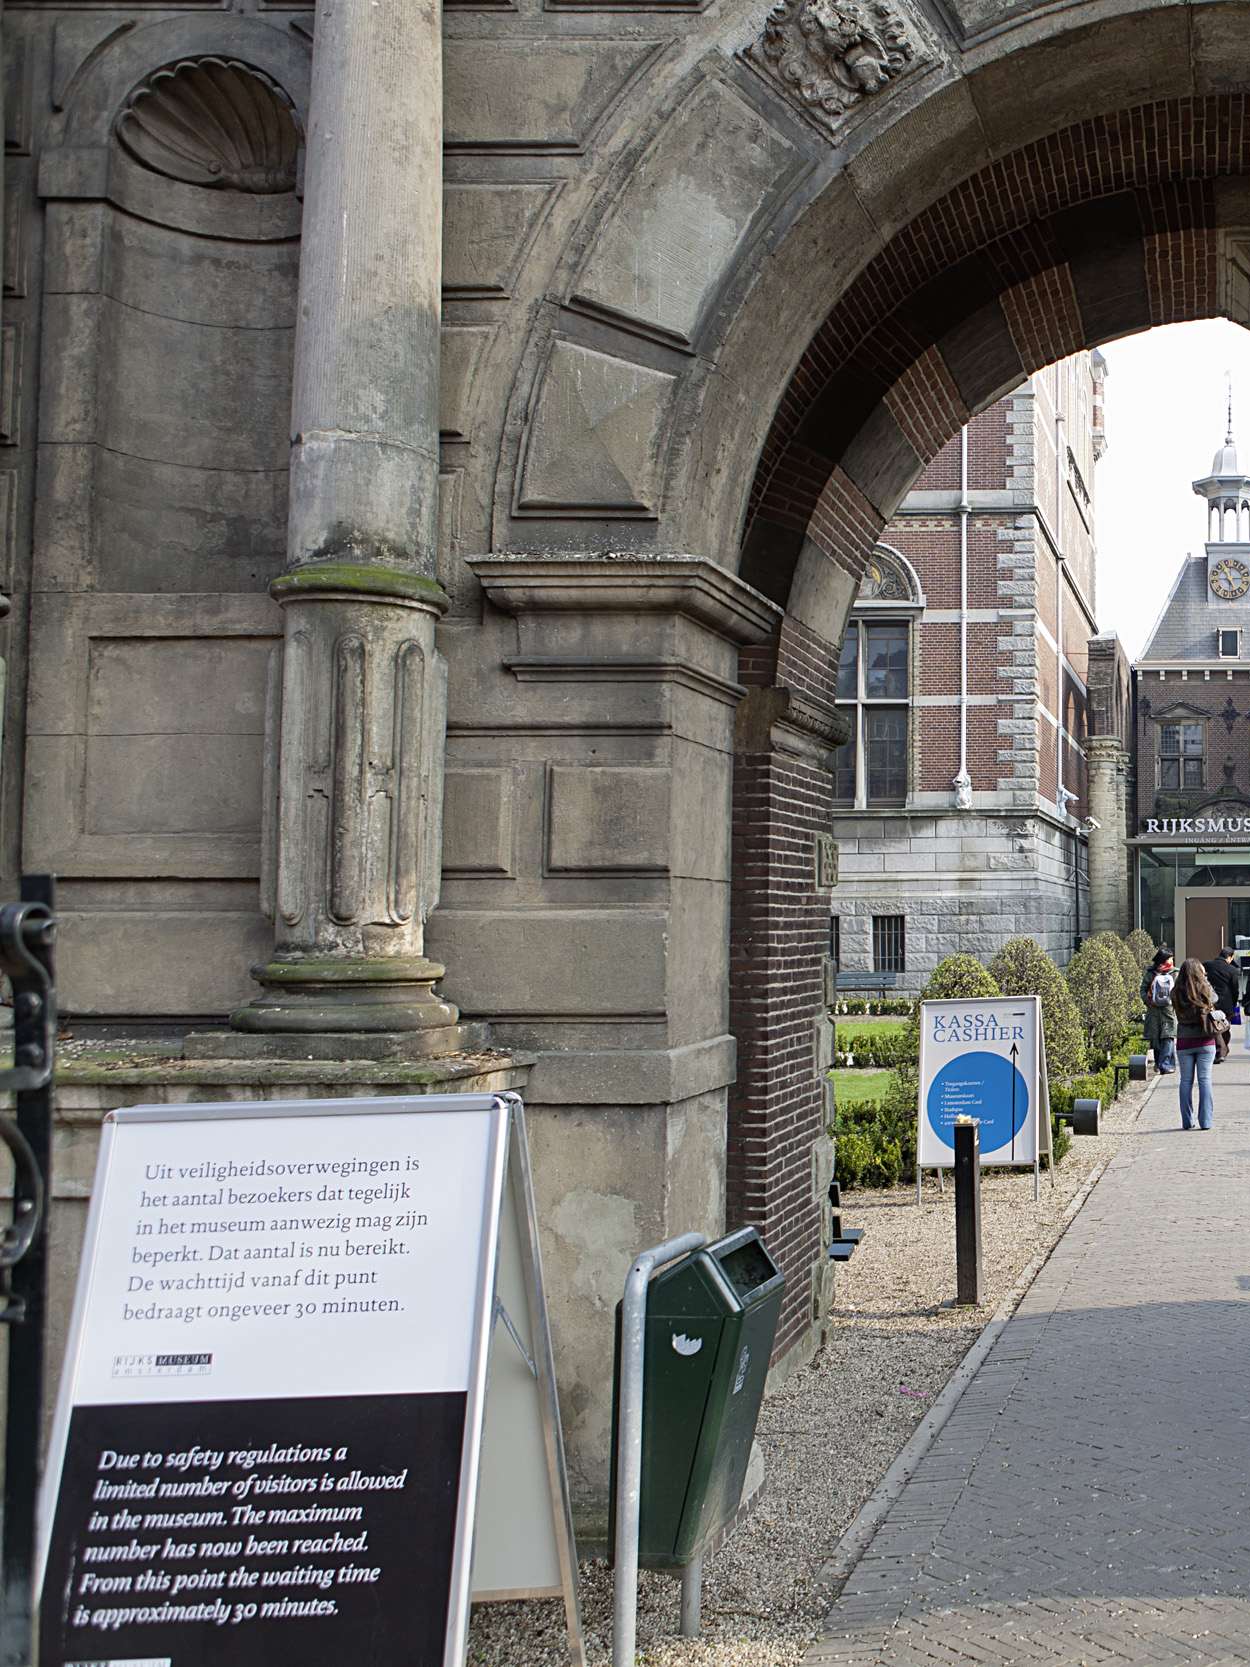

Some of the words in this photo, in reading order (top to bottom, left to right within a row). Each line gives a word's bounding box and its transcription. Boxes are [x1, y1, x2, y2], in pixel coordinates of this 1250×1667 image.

[933, 1013, 999, 1029] KASSA
[933, 1026, 1025, 1042] CASHIER
[145, 1164, 173, 1180] Uit
[179, 1157, 400, 1182] veiligheidsoverwegingen
[406, 1155, 420, 1171] is
[140, 1191, 168, 1207] het
[172, 1189, 223, 1206] aantal
[228, 1186, 312, 1204] bezoekers
[317, 1185, 344, 1201] dat
[348, 1182, 411, 1204] tegelijk
[136, 1220, 153, 1236] in
[158, 1218, 186, 1235] het
[190, 1220, 265, 1234] museum
[270, 1213, 351, 1232] aanwezig
[355, 1215, 393, 1231] mag
[395, 1210, 428, 1230] zijn
[132, 1245, 203, 1268] beperkt.
[208, 1245, 240, 1261] Dat
[243, 1242, 295, 1260] aantal
[299, 1242, 314, 1257] is
[318, 1244, 340, 1257] nu
[345, 1238, 411, 1257] bereikt.
[127, 1276, 154, 1292] De
[160, 1271, 245, 1293] wachttijd
[250, 1269, 303, 1288] vanaf
[304, 1268, 330, 1286] dit
[334, 1271, 379, 1290] punt
[123, 1302, 202, 1323] bedraagt
[207, 1302, 291, 1322] ongeveer
[295, 1302, 317, 1319] 30
[322, 1297, 405, 1314] minuten.
[98, 1450, 140, 1470] Due
[142, 1452, 163, 1468] to
[164, 1446, 224, 1472] safety
[226, 1443, 332, 1469] regulations
[334, 1447, 348, 1461] a
[92, 1477, 160, 1500] limited
[158, 1476, 232, 1498] number
[232, 1474, 258, 1500] of
[253, 1474, 317, 1495] visitors
[319, 1473, 334, 1492] is
[336, 1469, 408, 1491] allowed
[88, 1511, 108, 1532] in
[111, 1508, 142, 1531] the
[143, 1511, 227, 1530] museum.
[231, 1504, 265, 1526] The
[267, 1503, 363, 1524] maximum
[83, 1539, 160, 1563] number
[160, 1538, 197, 1560] has
[199, 1541, 242, 1558] now
[244, 1535, 289, 1557] been
[292, 1531, 369, 1554] reached.
[78, 1572, 132, 1595] From
[134, 1569, 171, 1592] this
[170, 1568, 226, 1596] point
[227, 1566, 260, 1588] the
[261, 1565, 336, 1589] waiting
[337, 1564, 381, 1584] time
[72, 1604, 90, 1627] is
[91, 1598, 232, 1631] approximately
[231, 1603, 257, 1624] 30
[260, 1596, 339, 1619] minutes.
